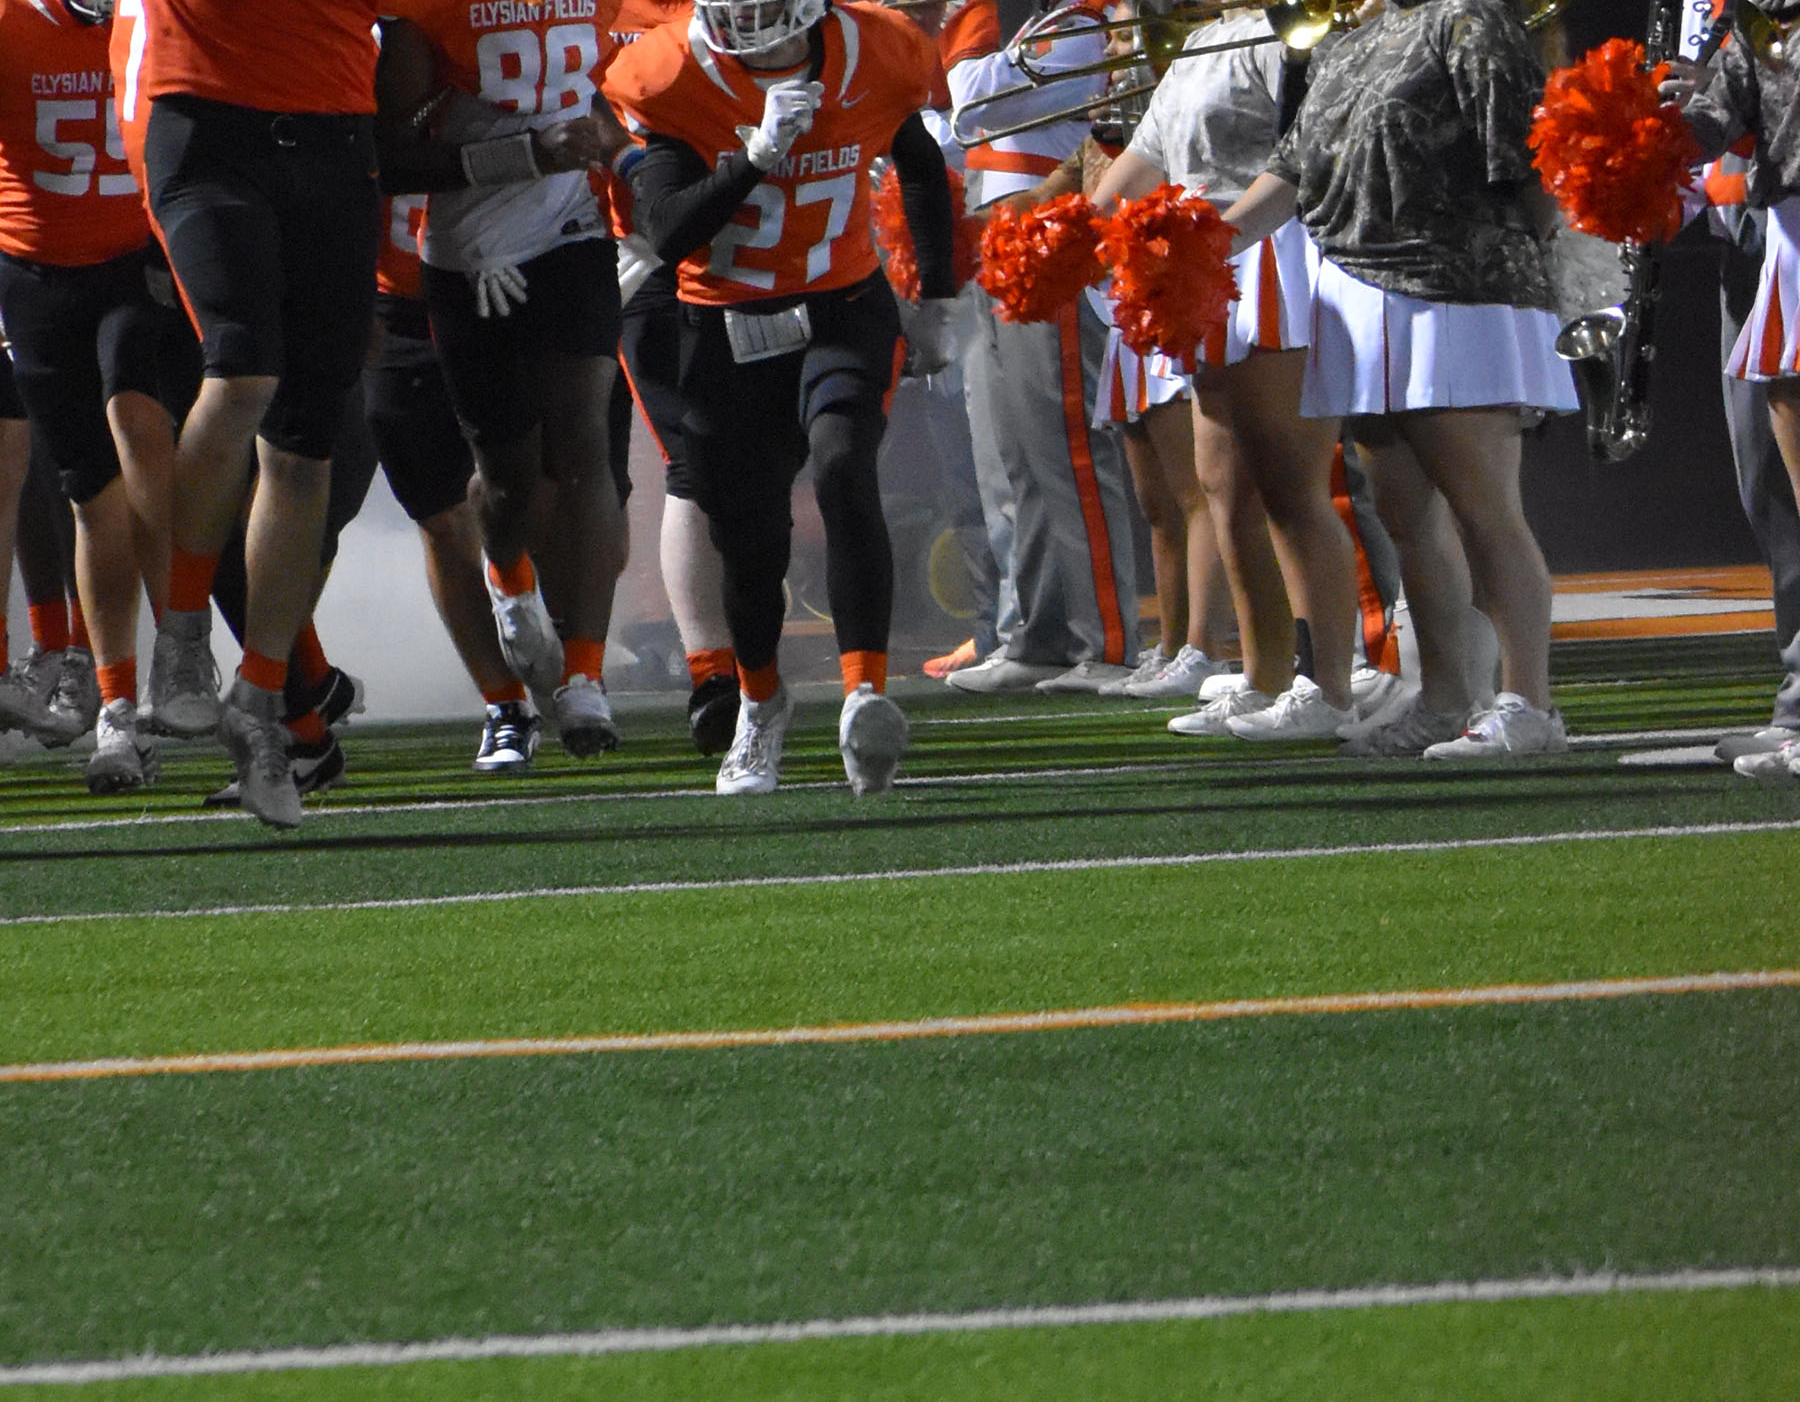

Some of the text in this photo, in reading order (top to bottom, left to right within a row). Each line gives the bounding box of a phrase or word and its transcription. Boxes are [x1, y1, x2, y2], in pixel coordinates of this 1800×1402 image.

[470, 0, 541, 28] ELYSIAN
[32, 71, 103, 94] ELYSIAN
[476, 23, 599, 119] 88
[800, 144, 861, 175] FIELDS
[708, 172, 857, 291] 27
